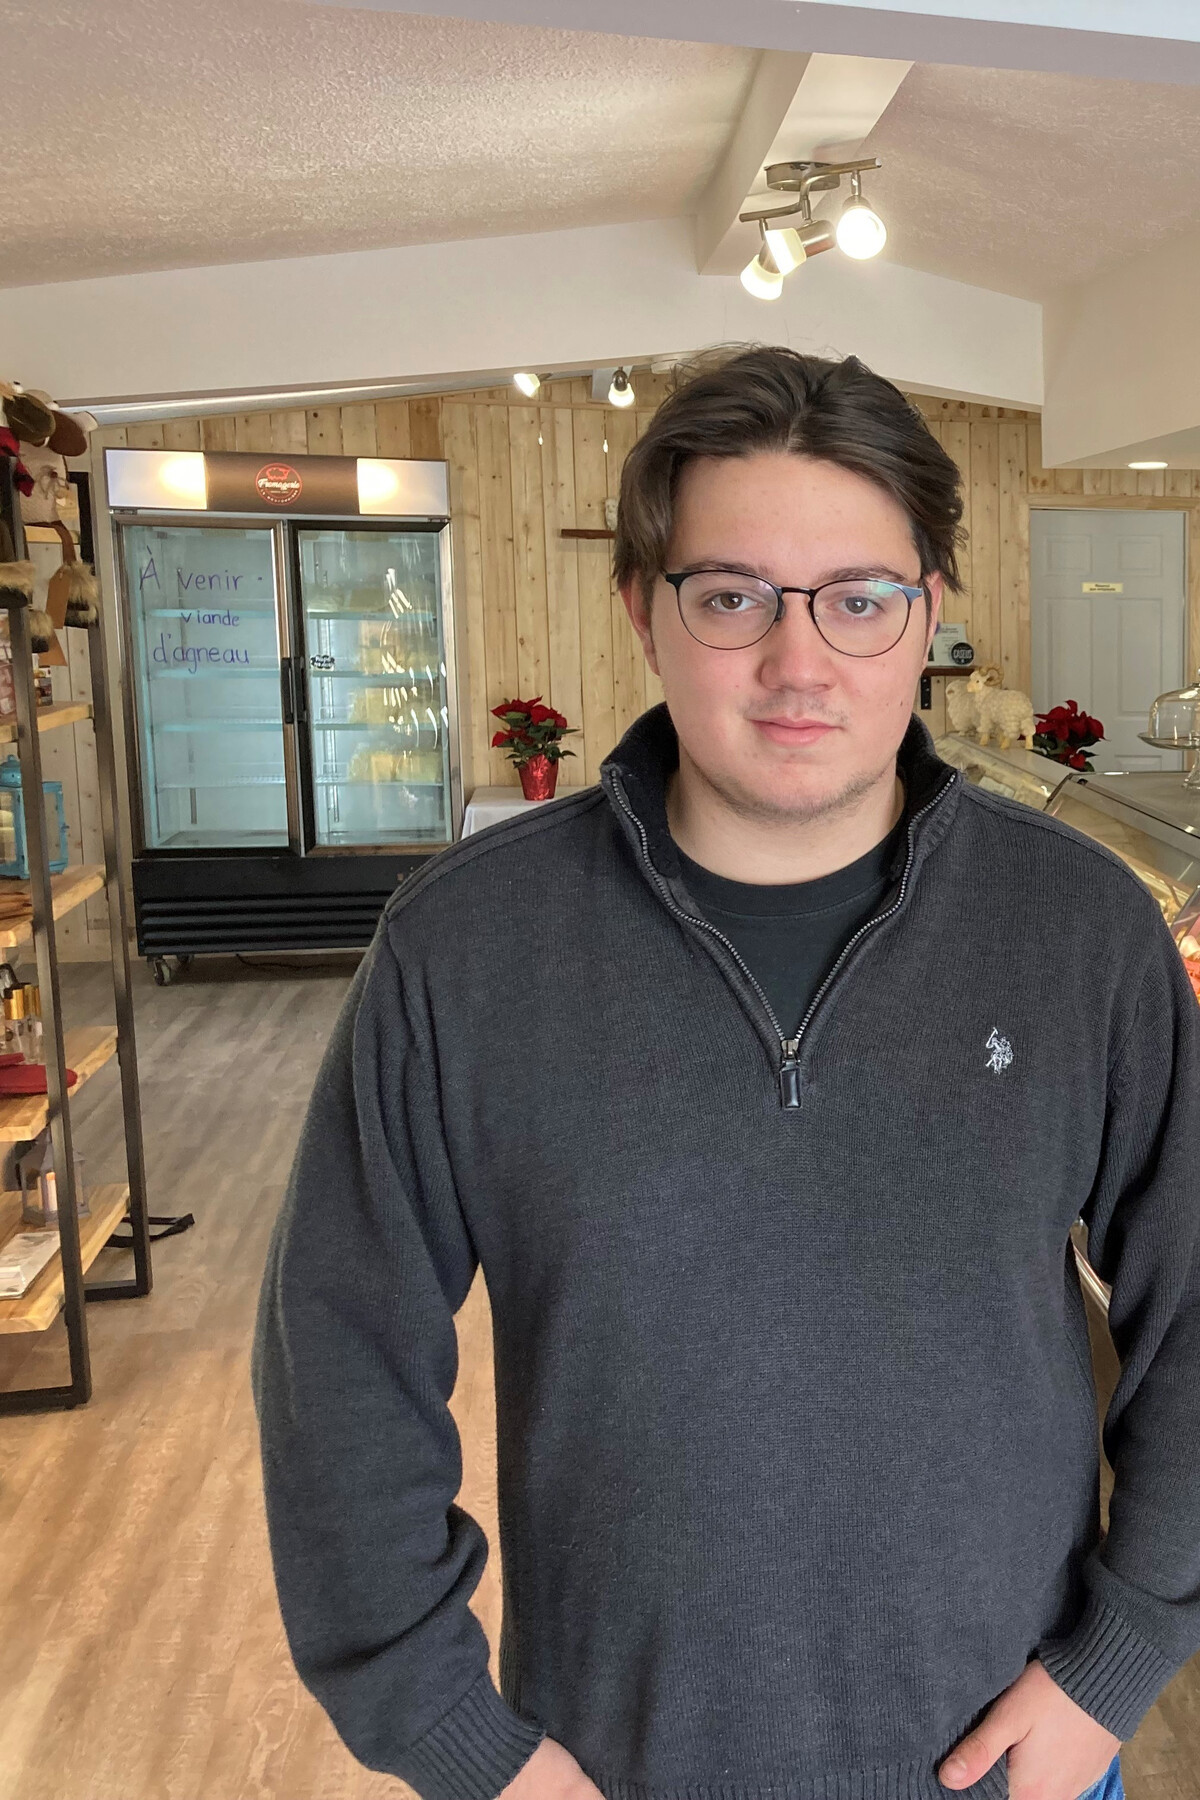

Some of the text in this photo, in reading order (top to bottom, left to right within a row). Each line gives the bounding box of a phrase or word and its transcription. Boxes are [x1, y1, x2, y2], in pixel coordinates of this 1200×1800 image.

[258, 478, 300, 490] Fromagerie
[139, 545, 160, 591] À
[181, 609, 240, 627] viande
[153, 632, 250, 674] d'agneau
